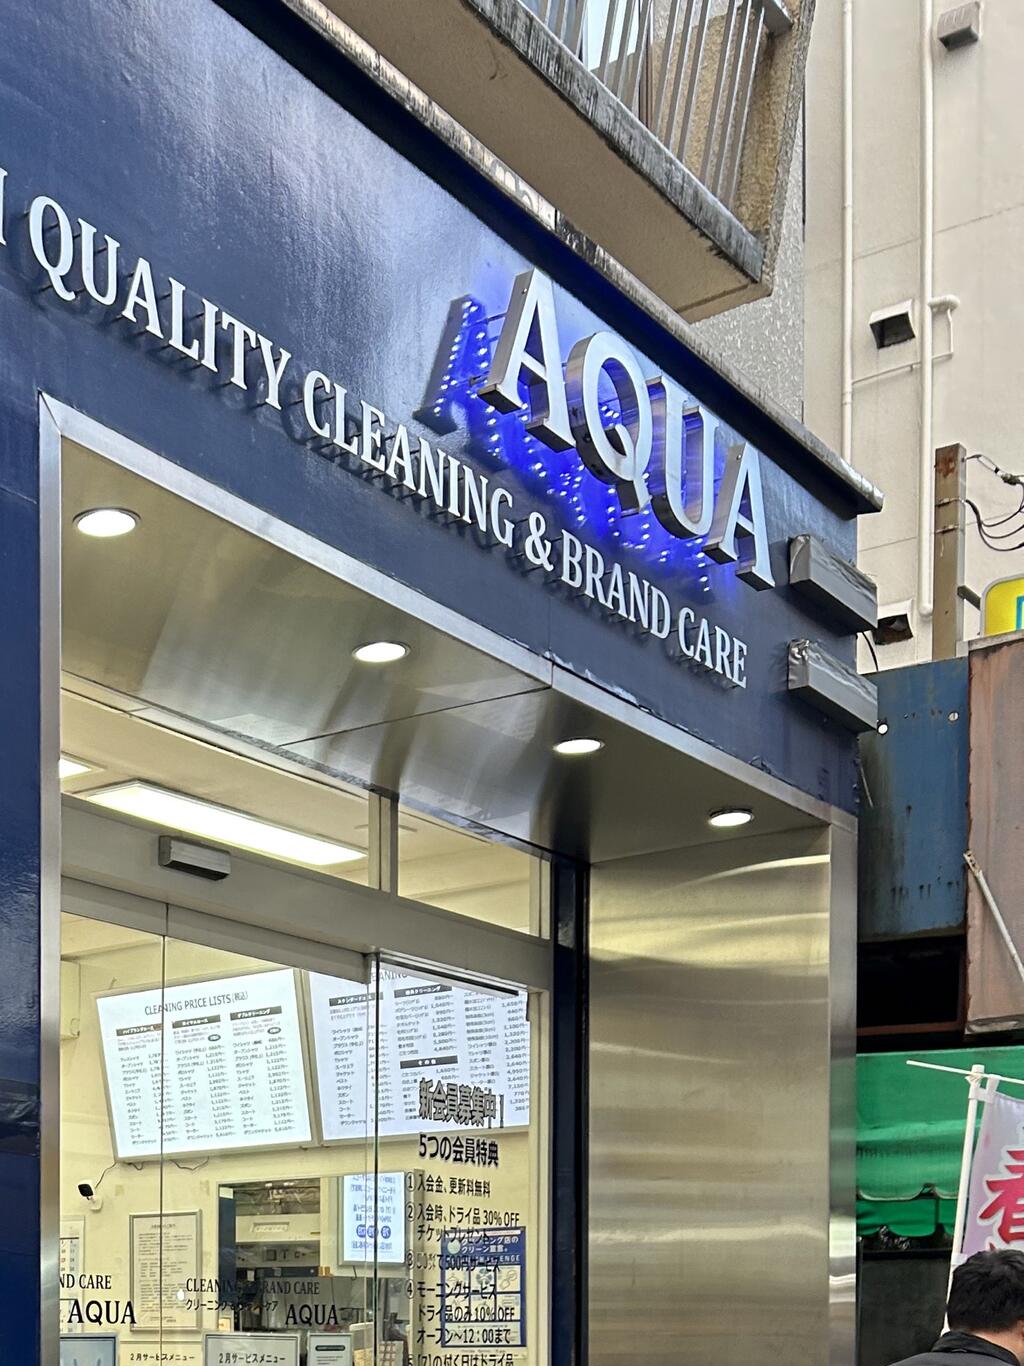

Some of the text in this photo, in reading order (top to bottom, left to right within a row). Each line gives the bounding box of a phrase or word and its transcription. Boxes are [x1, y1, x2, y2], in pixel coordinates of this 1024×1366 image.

[478, 267, 775, 591] AQUA
[28, 195, 292, 411] QUALITY
[303, 369, 516, 549] CLEANING
[524, 511, 554, 572] &
[560, 528, 672, 640] BRAND
[678, 606, 748, 689] CARE
[144, 1000, 184, 1016] CLEANING
[183, 997, 208, 1010] PRICE
[418, 1134, 499, 1168] 5つの会員特典
[417, 1174, 491, 1198] 入会金、更新料無料
[483, 1210, 502, 1226] 30%
[503, 1211, 520, 1227] OFF
[78, 1274, 112, 1290] CARE
[293, 1281, 320, 1295] CARE
[417, 1281, 498, 1300] モーニングサービス
[67, 1299, 137, 1326] AQUA
[285, 1304, 339, 1327] AQUA
[498, 1306, 515, 1321] OFF
[218, 1353, 286, 1365] 2月サービスメニュー
